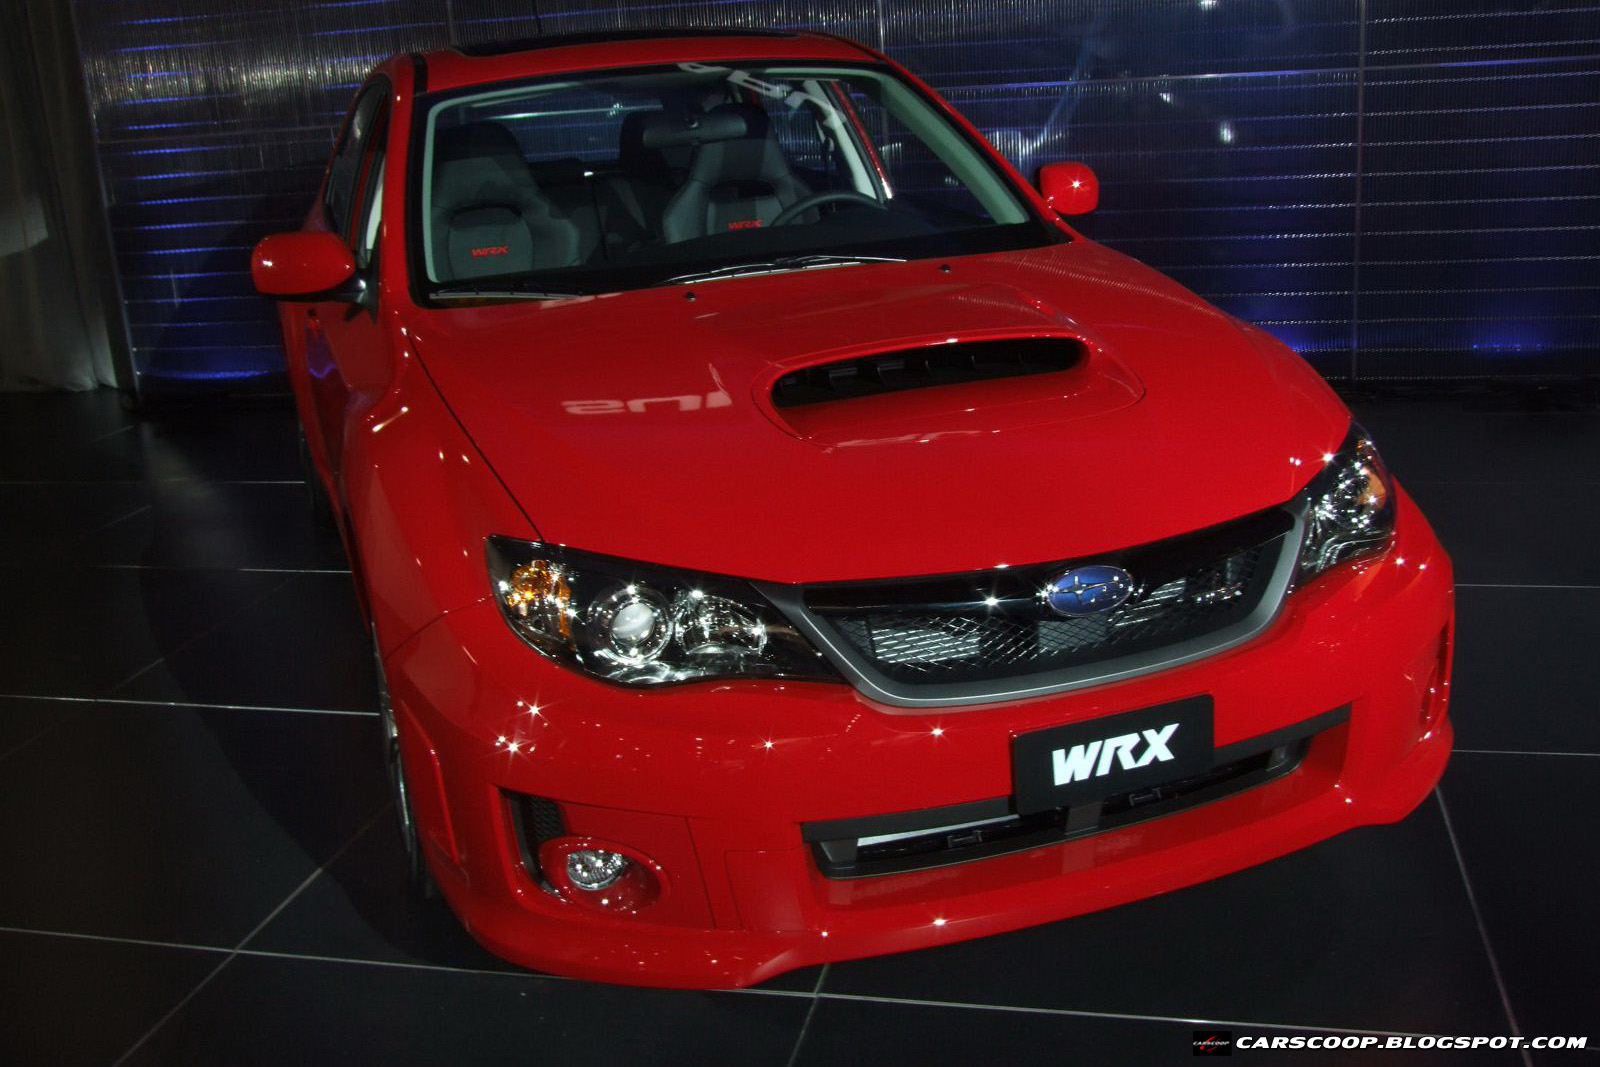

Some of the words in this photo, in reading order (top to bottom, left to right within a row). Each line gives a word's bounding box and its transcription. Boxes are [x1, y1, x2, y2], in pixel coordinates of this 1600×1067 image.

[728, 219, 762, 230] WRX
[471, 245, 509, 257] WRX
[1052, 723, 1180, 786] WRX
